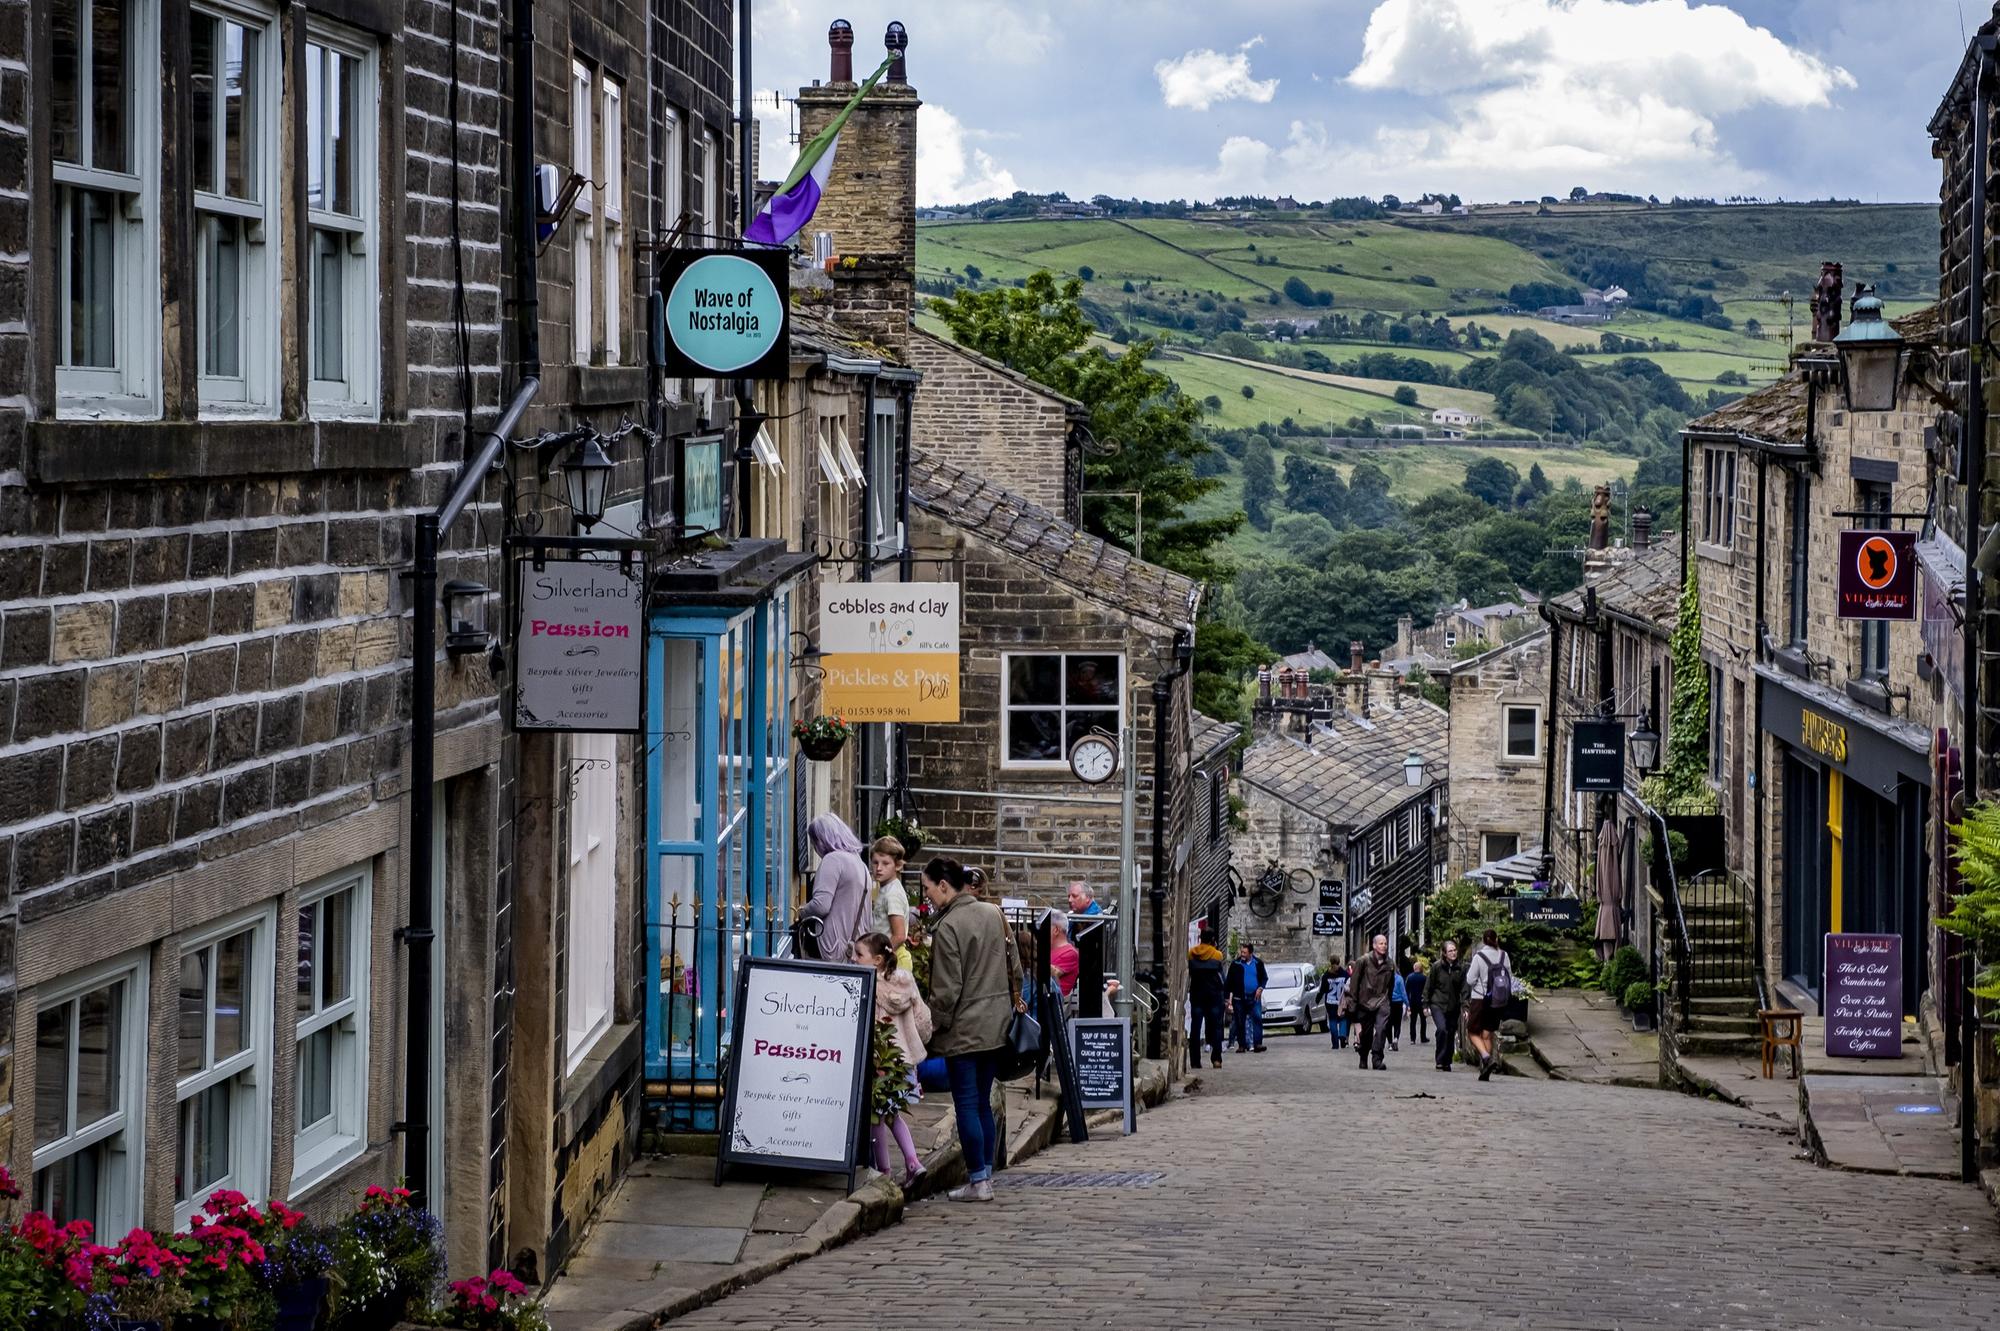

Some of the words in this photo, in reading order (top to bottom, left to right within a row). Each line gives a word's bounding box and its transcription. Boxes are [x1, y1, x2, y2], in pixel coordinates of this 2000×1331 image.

[695, 288, 733, 308] Wave
[738, 287, 753, 308] of
[689, 311, 759, 335] Nostalgia
[532, 577, 629, 601] Silverland
[889, 600, 915, 615] and
[530, 619, 630, 638] Passion
[527, 667, 563, 677] Bespoke
[566, 667, 592, 677] Silver
[595, 668, 639, 680] Jewellery
[828, 668, 889, 686] Pickles
[893, 669, 909, 688] &
[914, 669, 950, 686] Pots
[571, 683, 593, 693] Gifts
[920, 678, 950, 702] Deli
[556, 710, 608, 719] Accessories
[830, 706, 845, 717] Tel:
[847, 706, 875, 716] 01535
[877, 706, 893, 716] 958
[895, 706, 911, 716] 961
[1525, 912, 1570, 920] HAWTHORN
[1834, 939, 1893, 949] VILLETTE
[1866, 963, 1889, 975] Cold
[1840, 976, 1886, 987] Sandwiches
[760, 992, 847, 1018] Silverland
[1840, 994, 1861, 1005] Oven
[1862, 995, 1886, 1006] Fresh
[1833, 1007, 1853, 1018] Pies
[1834, 1025, 1863, 1038] Freshly
[1865, 1028, 1893, 1038] Made
[754, 1039, 842, 1064] Passion
[1849, 1039, 1877, 1051] Coffees
[743, 1090, 776, 1101] Bespoke
[779, 1093, 802, 1103] Silver
[805, 1096, 845, 1110] Jewellery
[782, 1110, 802, 1120] Gifts
[766, 1136, 813, 1149] Accessories
